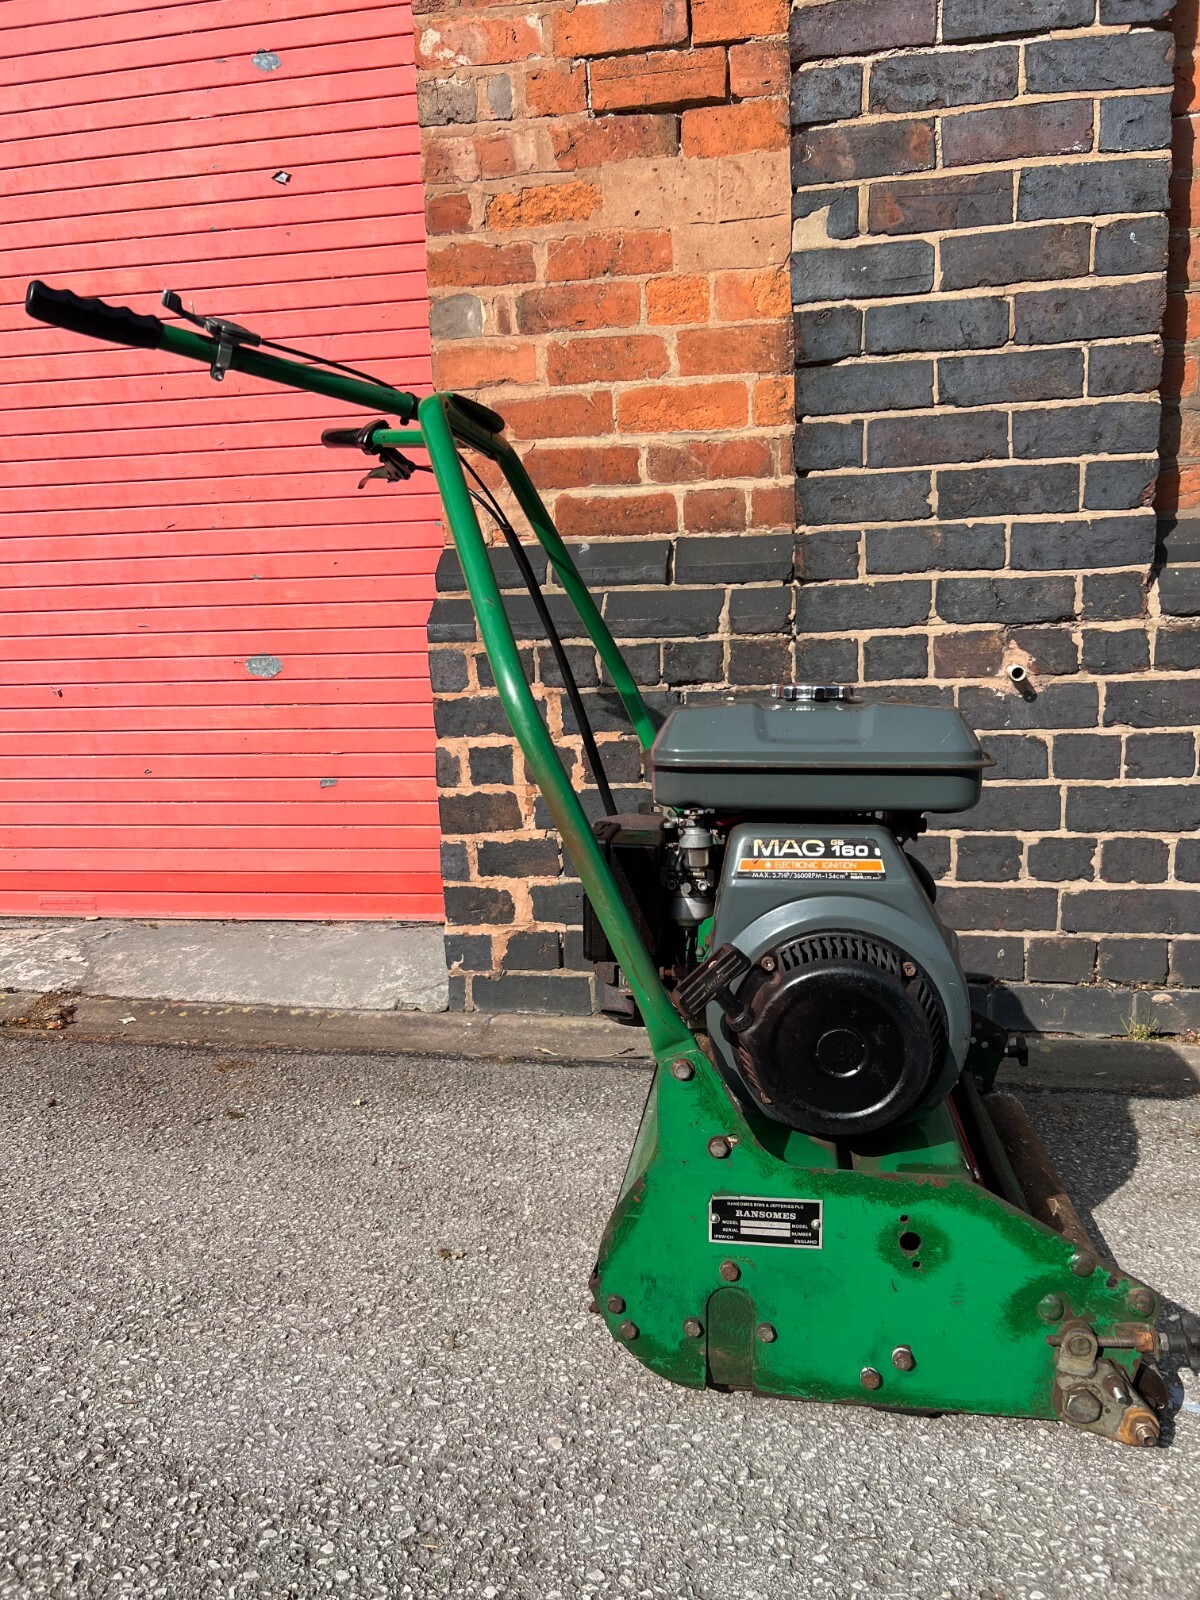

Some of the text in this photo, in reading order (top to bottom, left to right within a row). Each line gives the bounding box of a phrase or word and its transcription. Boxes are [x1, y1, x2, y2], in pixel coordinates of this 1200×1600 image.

[753, 839, 825, 857] MAG
[831, 845, 869, 857] 160
[774, 862, 857, 870] ELECTRONIC IGNITION
[735, 1209, 796, 1220] RANSOMES
